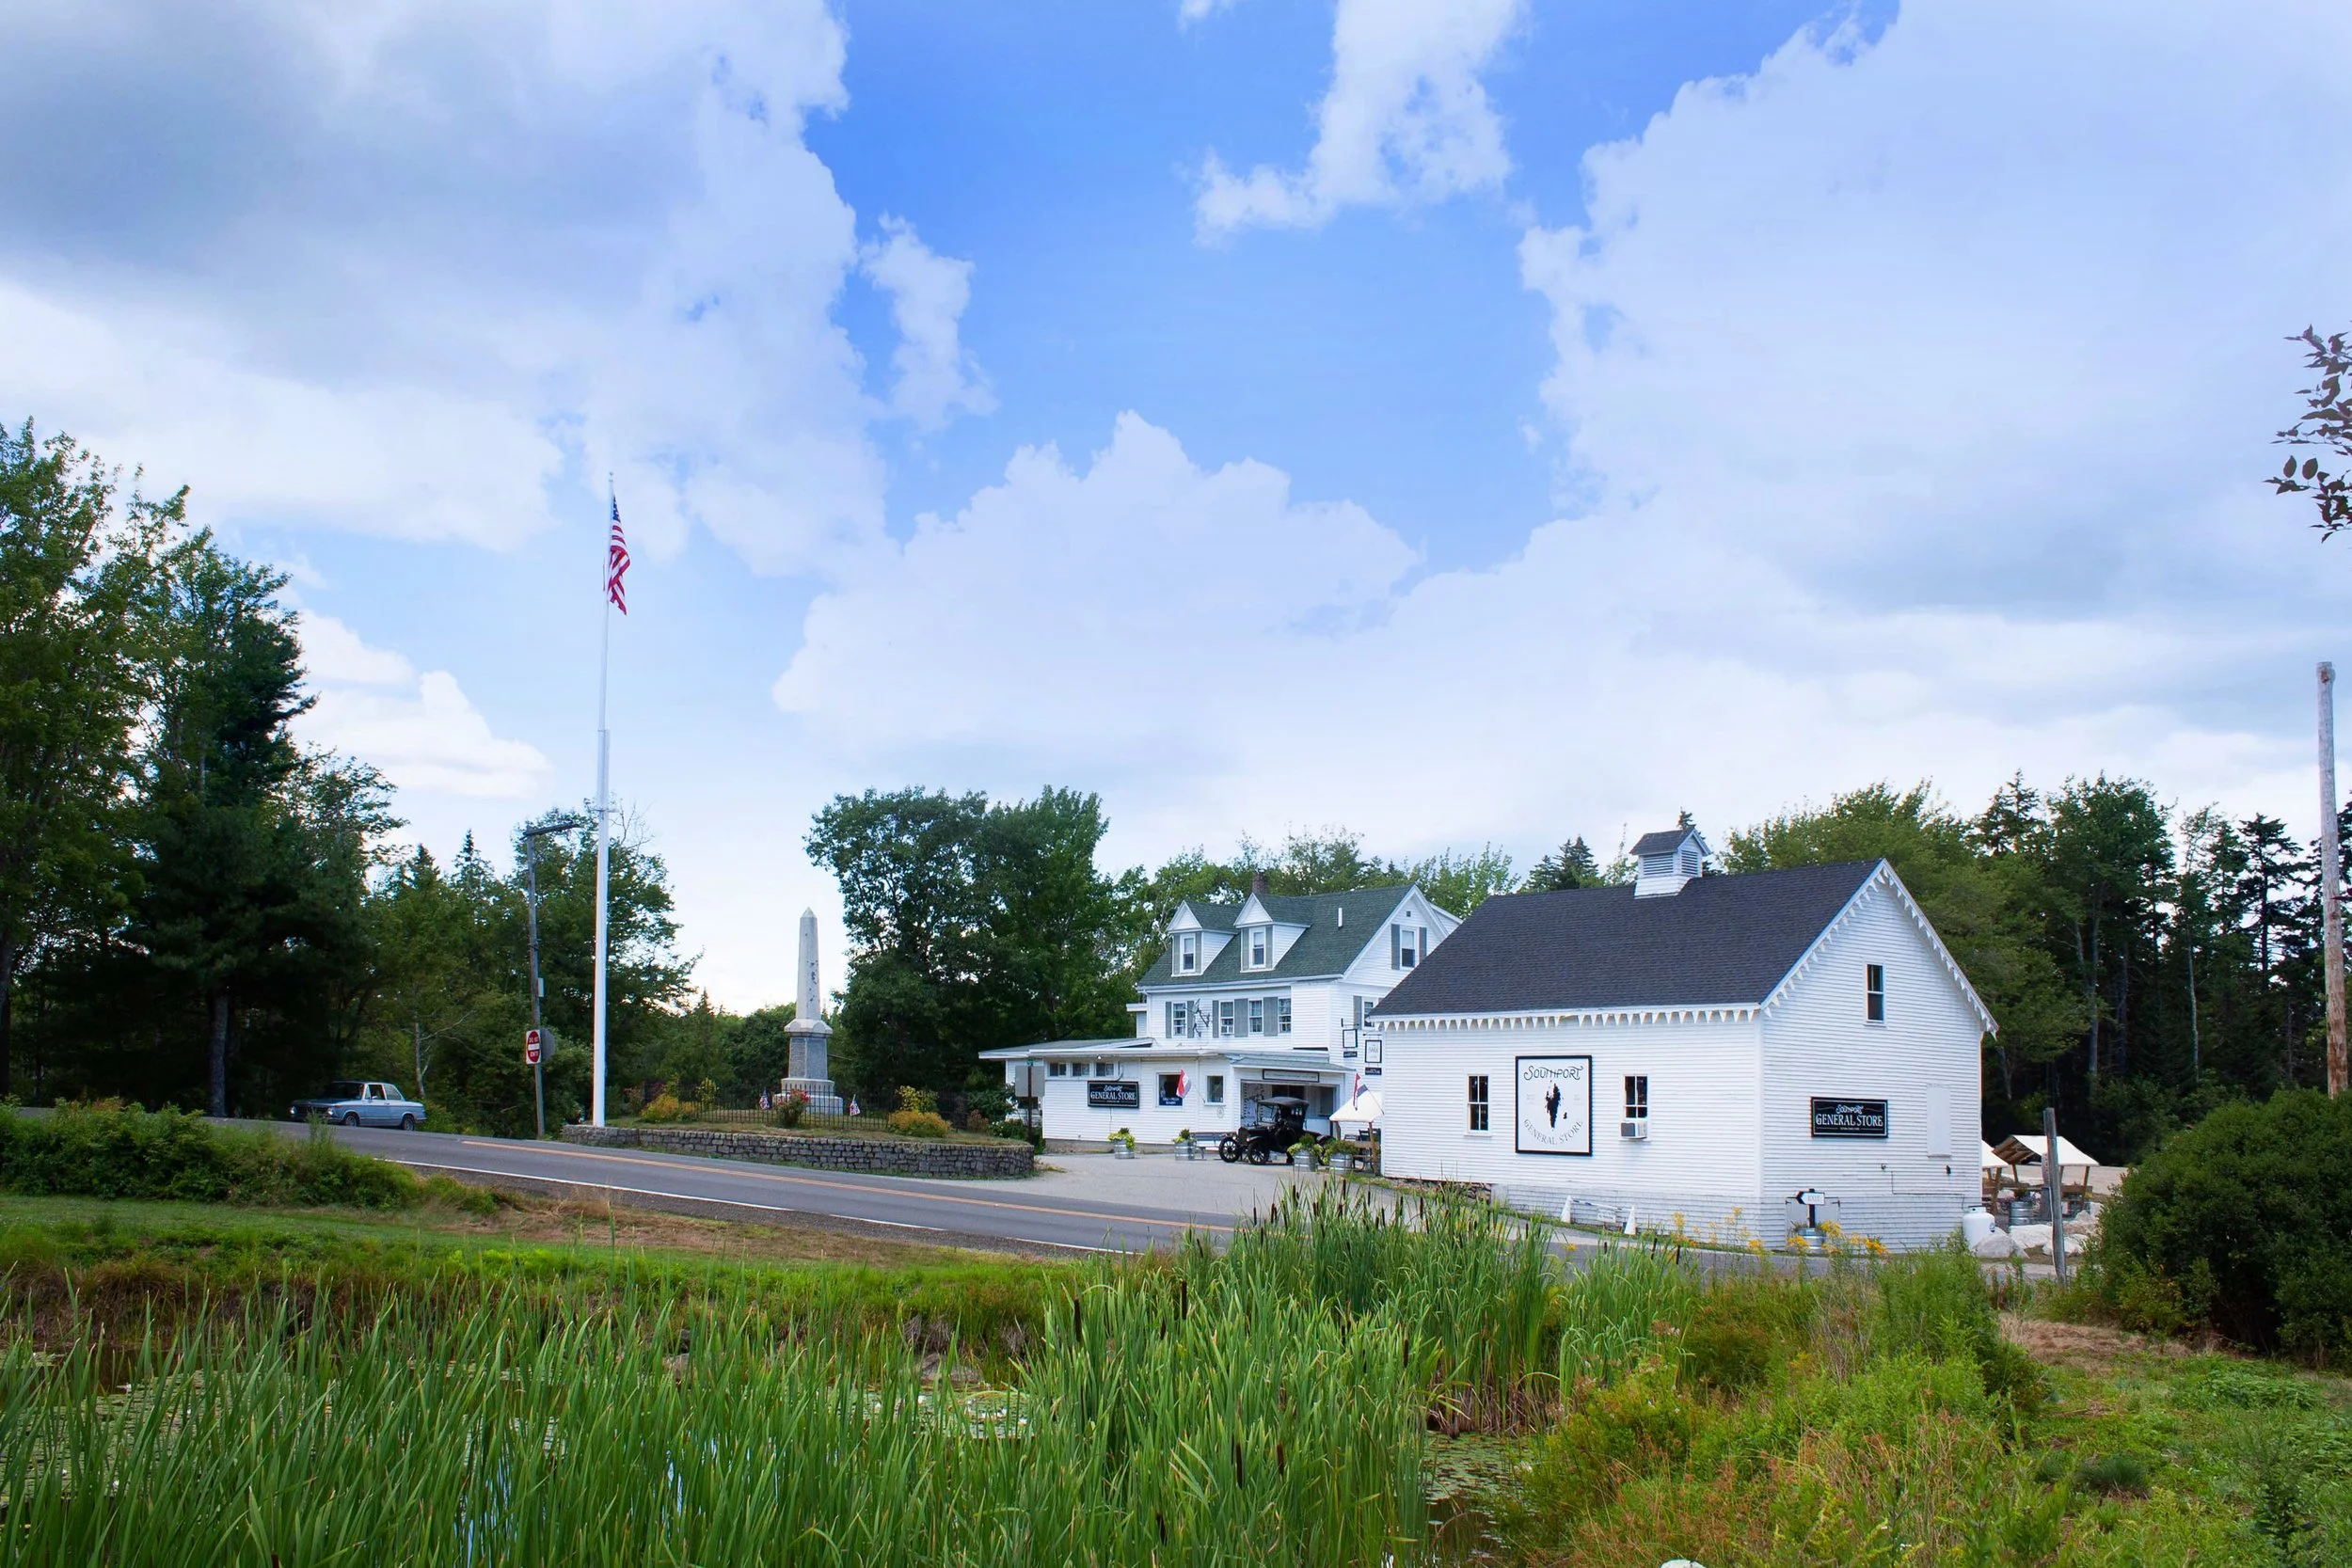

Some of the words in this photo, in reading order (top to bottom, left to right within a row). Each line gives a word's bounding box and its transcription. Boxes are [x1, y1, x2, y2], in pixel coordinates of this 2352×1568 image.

[1524, 1065, 1584, 1081] SOUTHPORT
[1090, 1091, 1117, 1100] GENERAL
[1816, 1114, 1855, 1126] GENERAL
[1856, 1115, 1883, 1126] STORE
[1524, 1119, 1557, 1145] GENERAL
[1559, 1120, 1583, 1143] STORE
